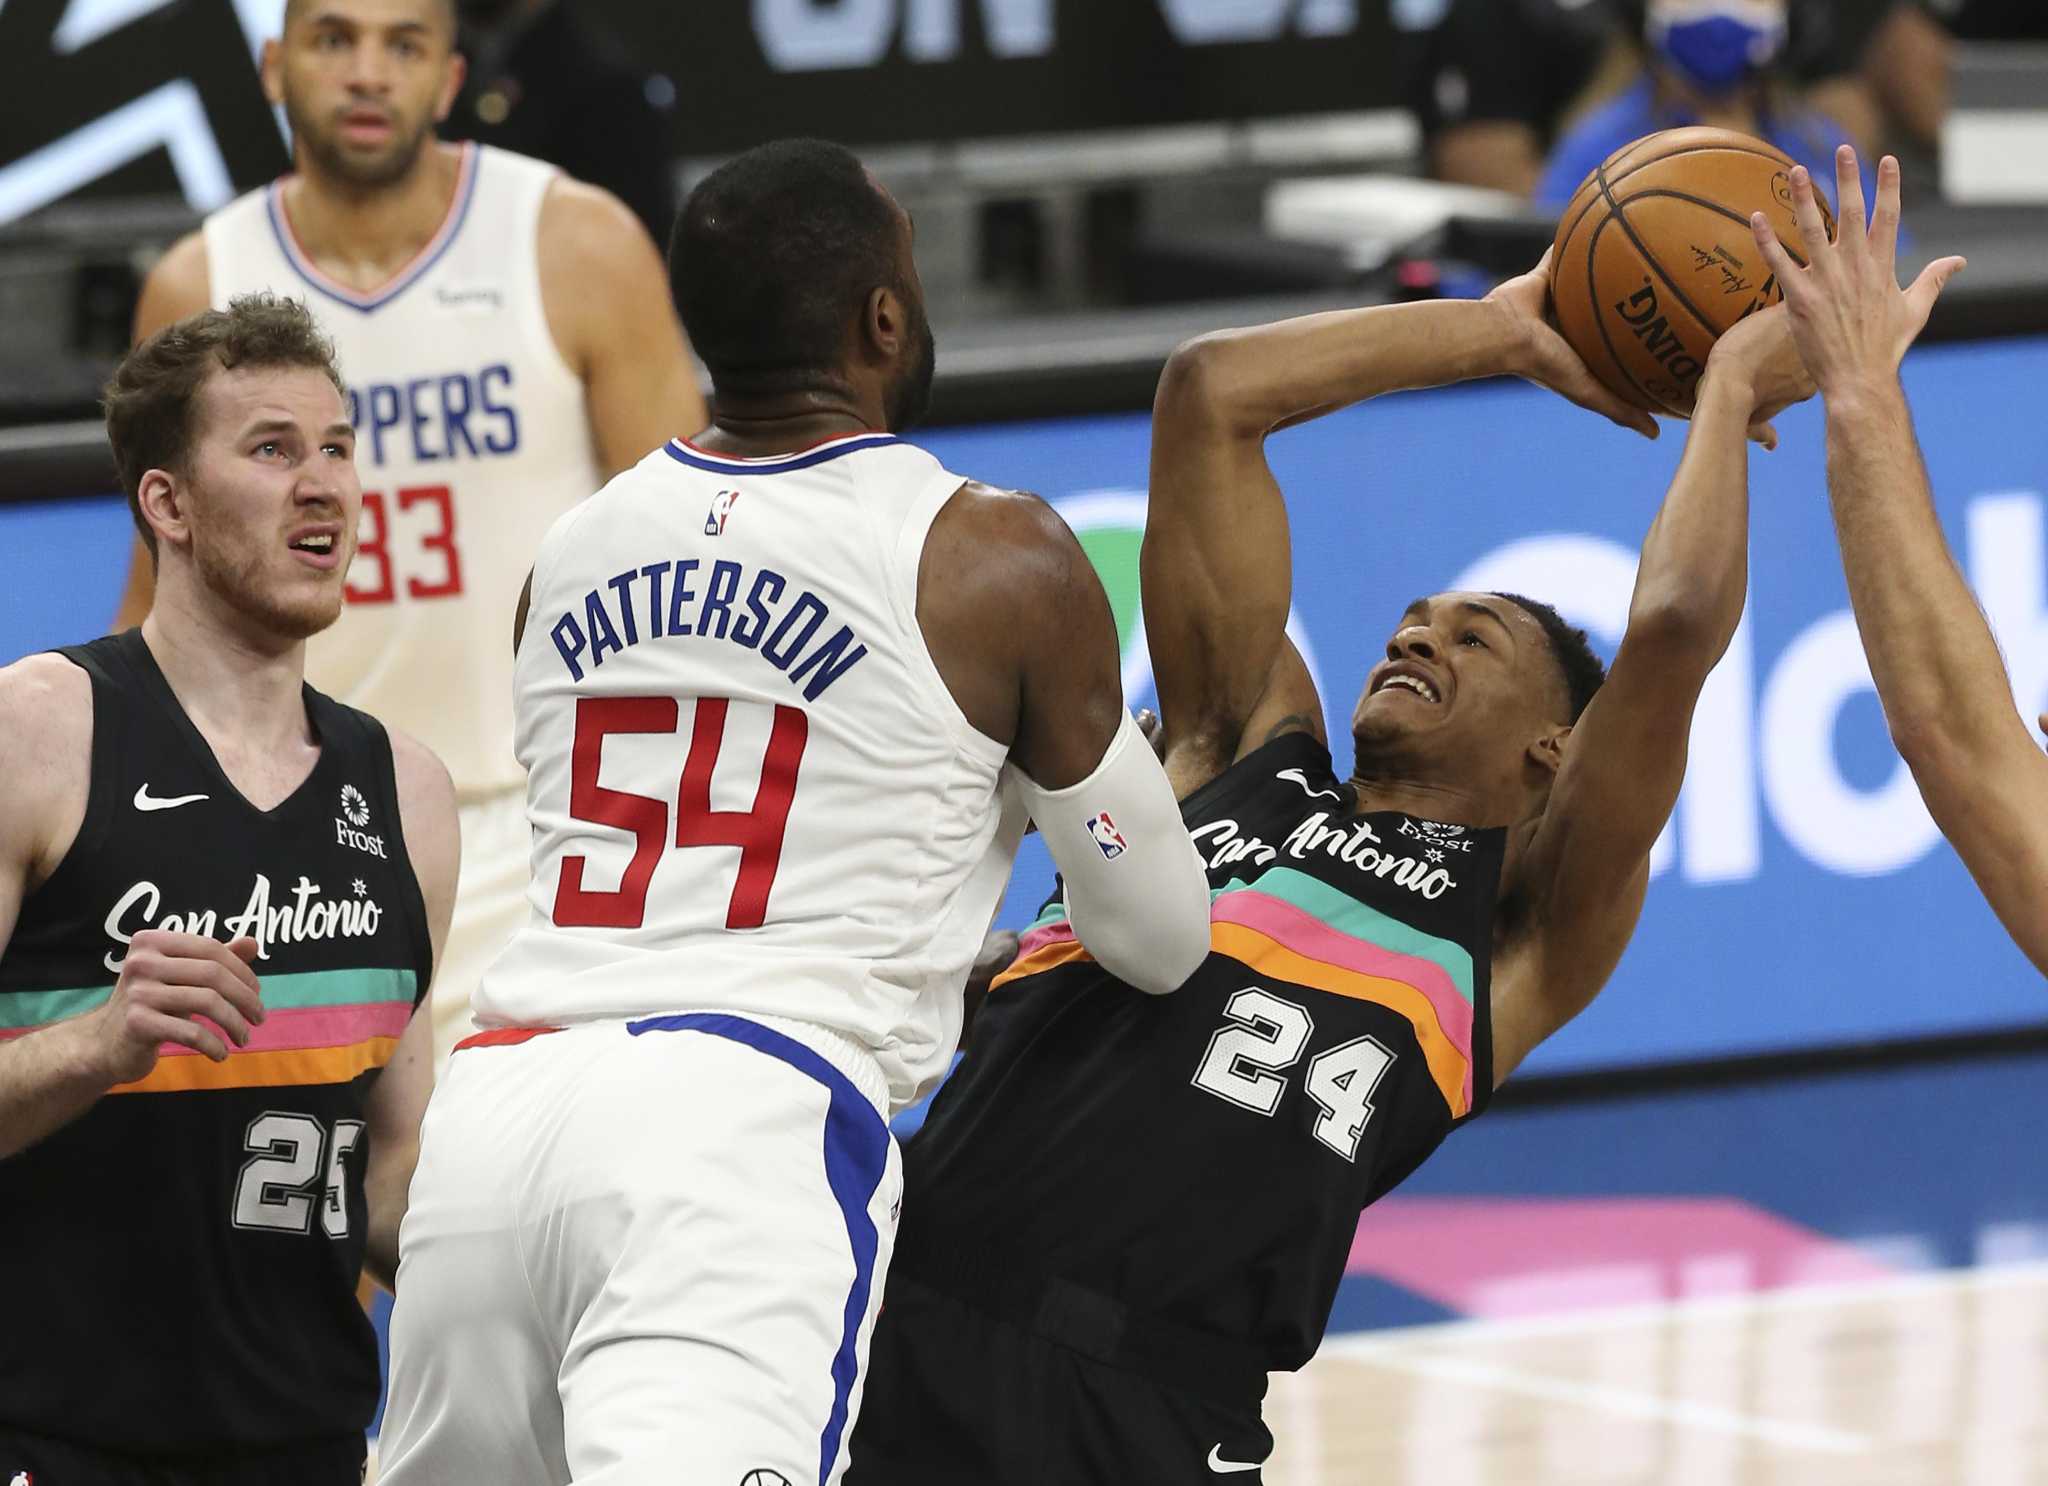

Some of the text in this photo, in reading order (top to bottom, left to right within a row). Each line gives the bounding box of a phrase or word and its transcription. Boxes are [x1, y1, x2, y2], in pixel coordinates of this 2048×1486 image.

[343, 485, 465, 606] 33
[550, 558, 868, 704] PATTERSON
[335, 817, 388, 860] Frost
[552, 695, 809, 930] 54
[1280, 811, 1458, 901] Antonio
[1396, 817, 1475, 853] Frost
[223, 872, 384, 961] Antonio
[1190, 985, 1399, 1164] 24
[231, 1109, 367, 1241] 25
